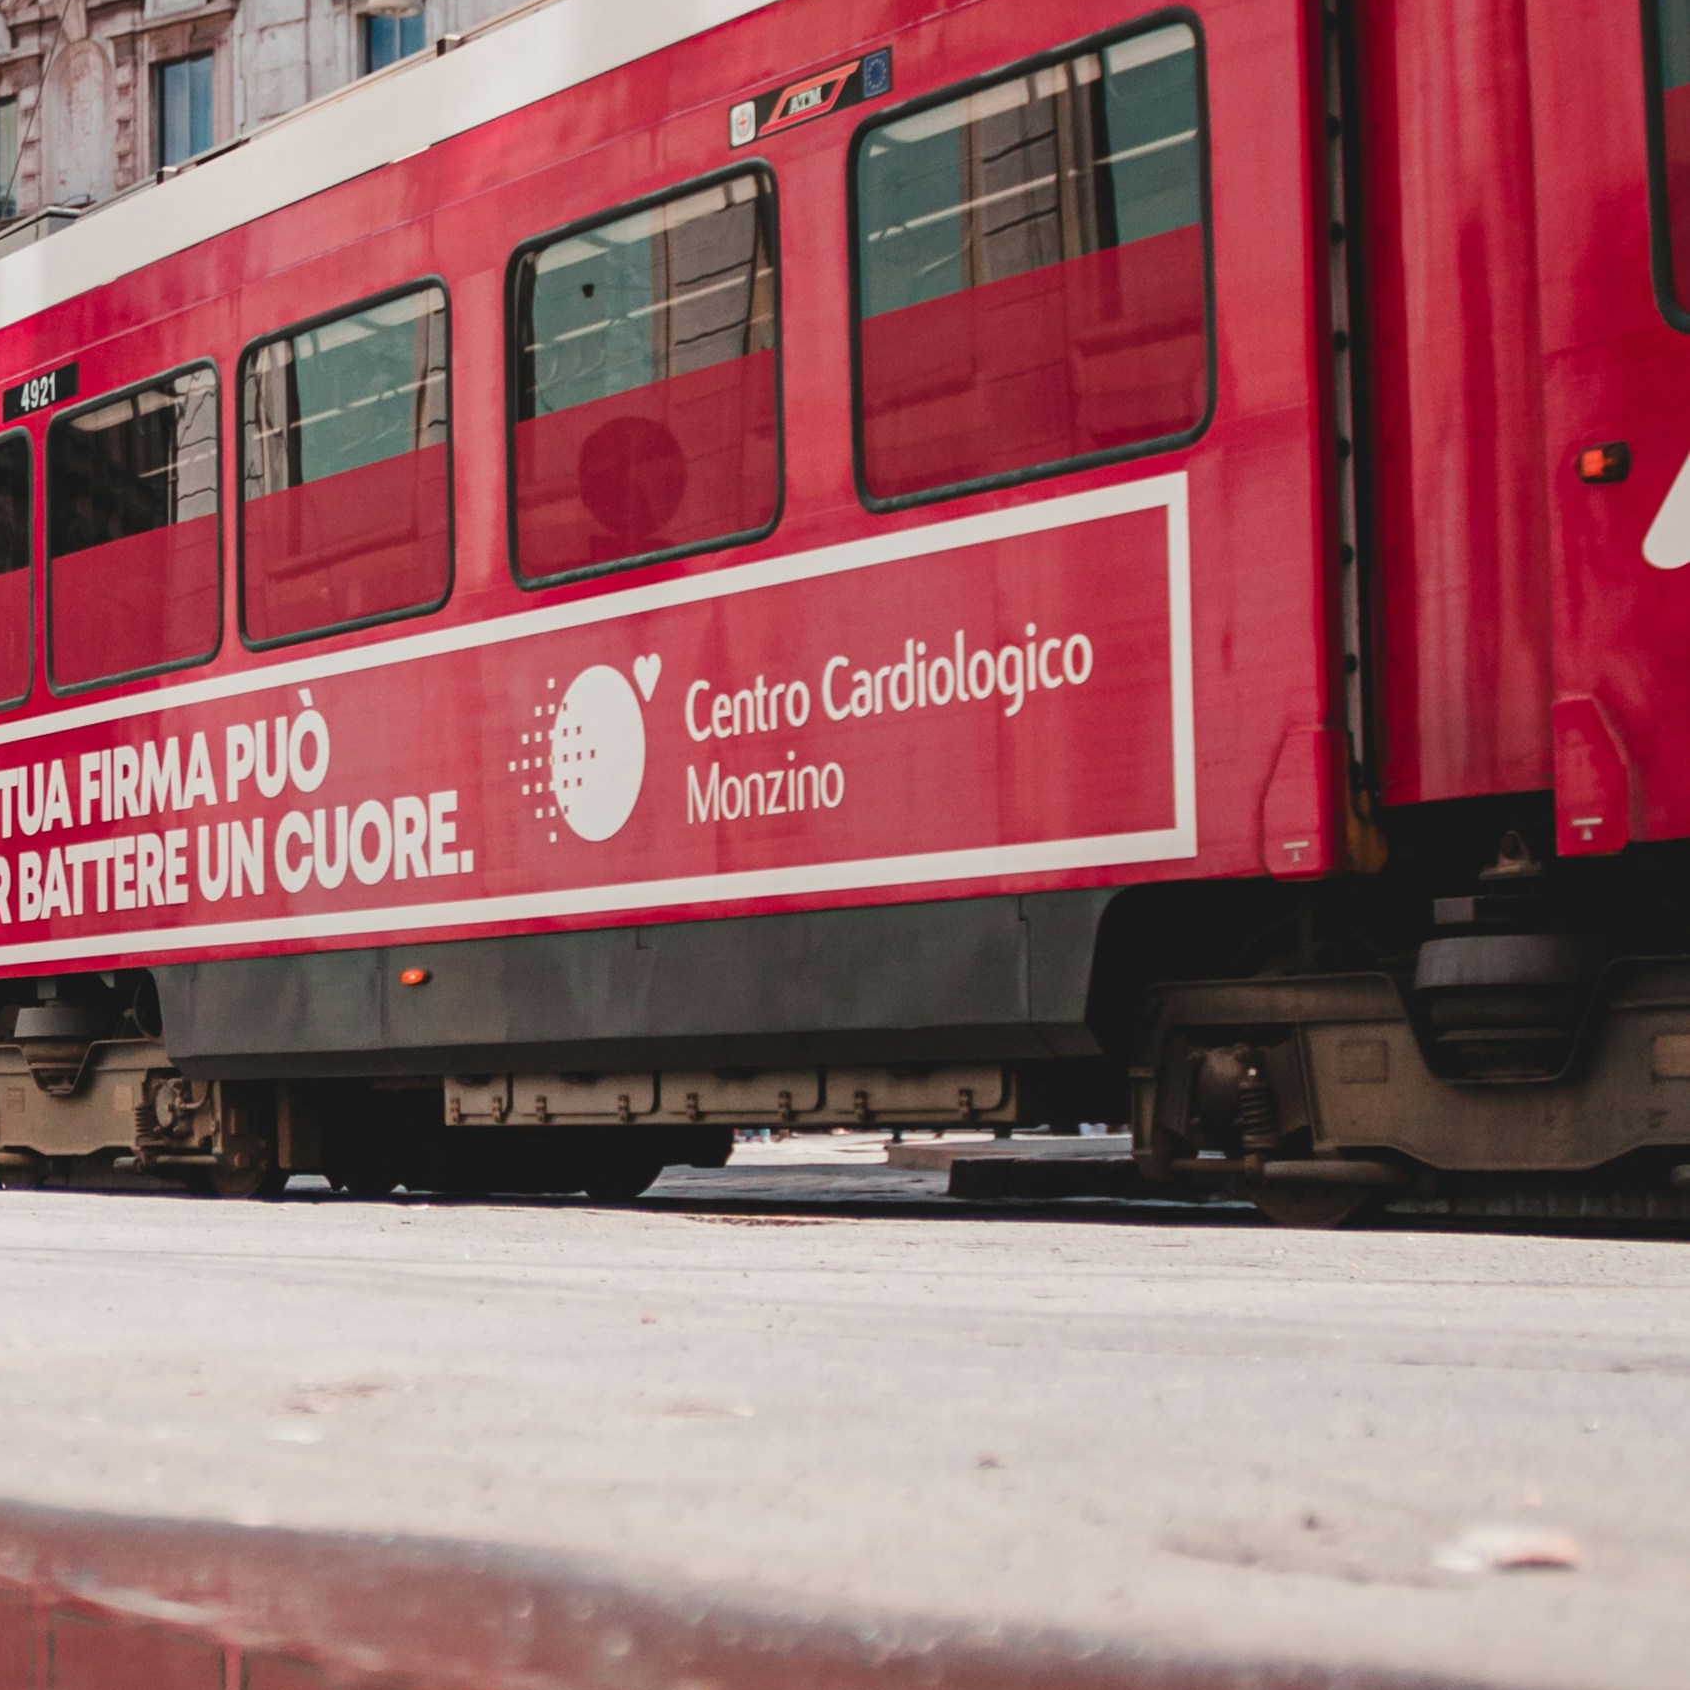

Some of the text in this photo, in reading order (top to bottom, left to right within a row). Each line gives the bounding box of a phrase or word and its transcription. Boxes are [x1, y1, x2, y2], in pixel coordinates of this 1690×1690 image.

[789, 87, 822, 114] ATM
[21, 371, 56, 412] 4921
[685, 623, 1092, 741] Centro Cardiologico
[81, 731, 217, 825] FIRMA
[226, 688, 330, 802] PUÒ
[687, 751, 844, 823] Monzino
[19, 829, 188, 921] BATTERE
[198, 817, 264, 901] UN
[275, 790, 473, 893] CUORE.
